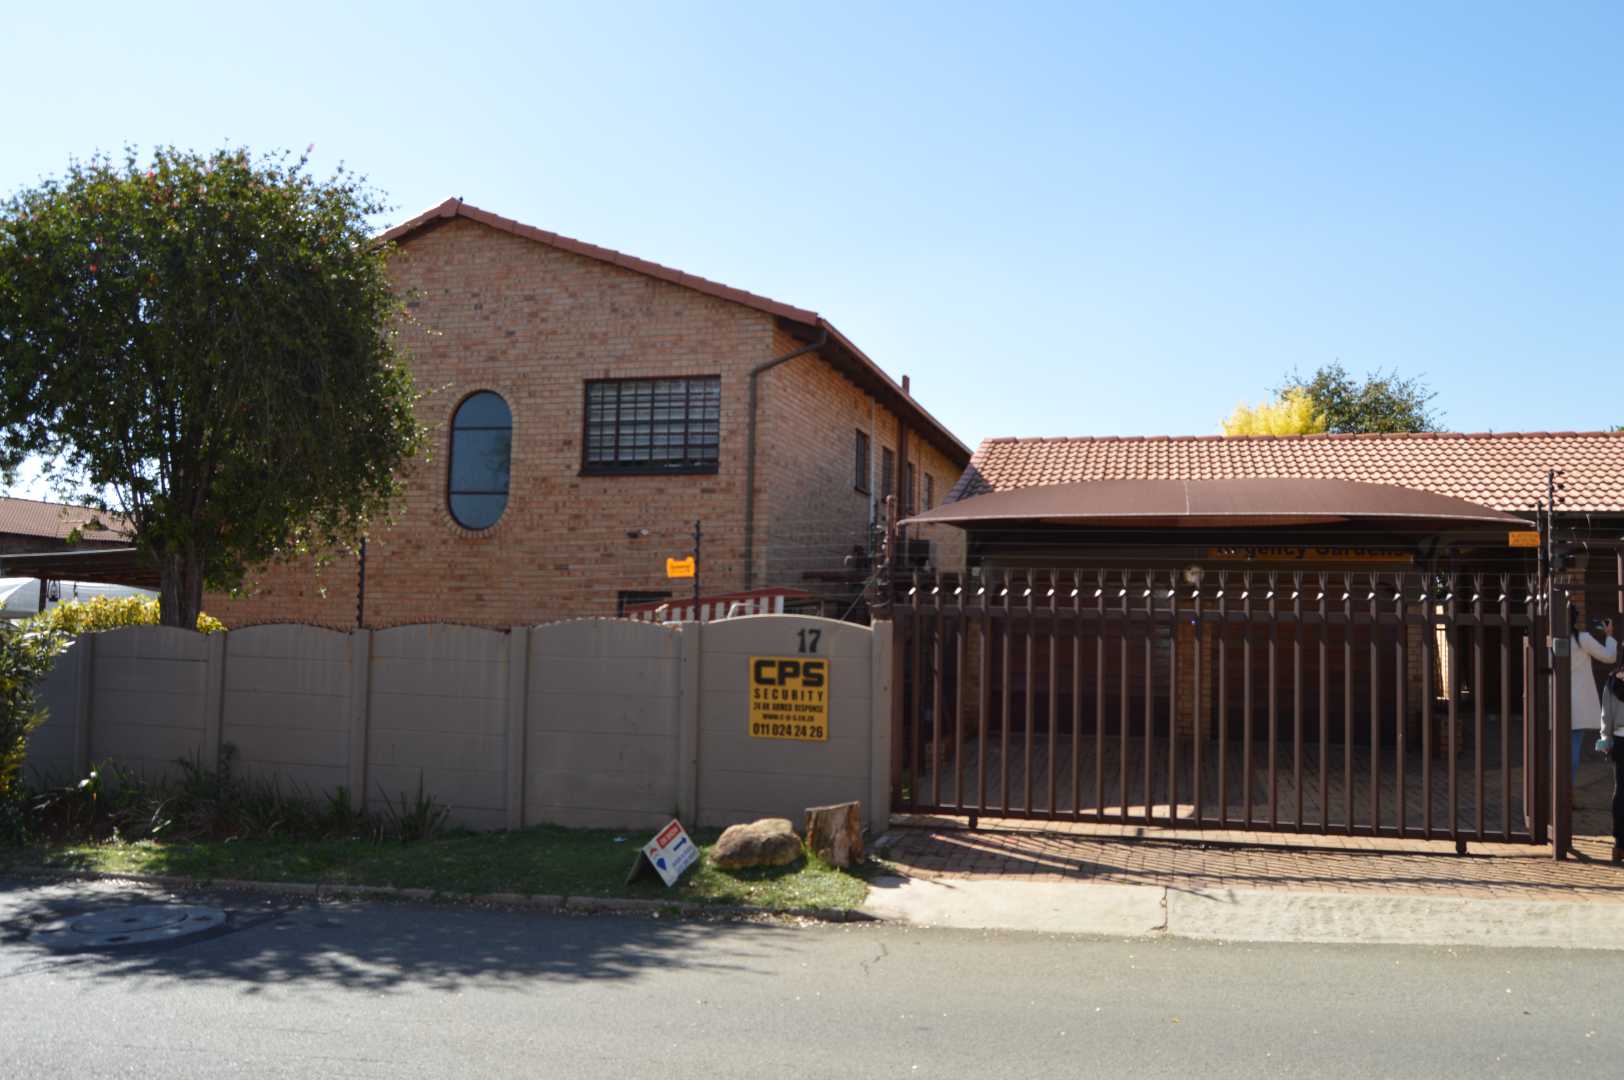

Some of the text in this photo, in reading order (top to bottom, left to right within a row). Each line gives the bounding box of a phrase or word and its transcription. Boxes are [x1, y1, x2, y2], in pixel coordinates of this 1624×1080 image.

[798, 628, 822, 653] 17
[754, 660, 824, 687] CPS
[753, 687, 824, 702] SECURITY
[795, 704, 824, 713] RESPONSE
[752, 722, 770, 735] 011
[772, 723, 792, 737] 024
